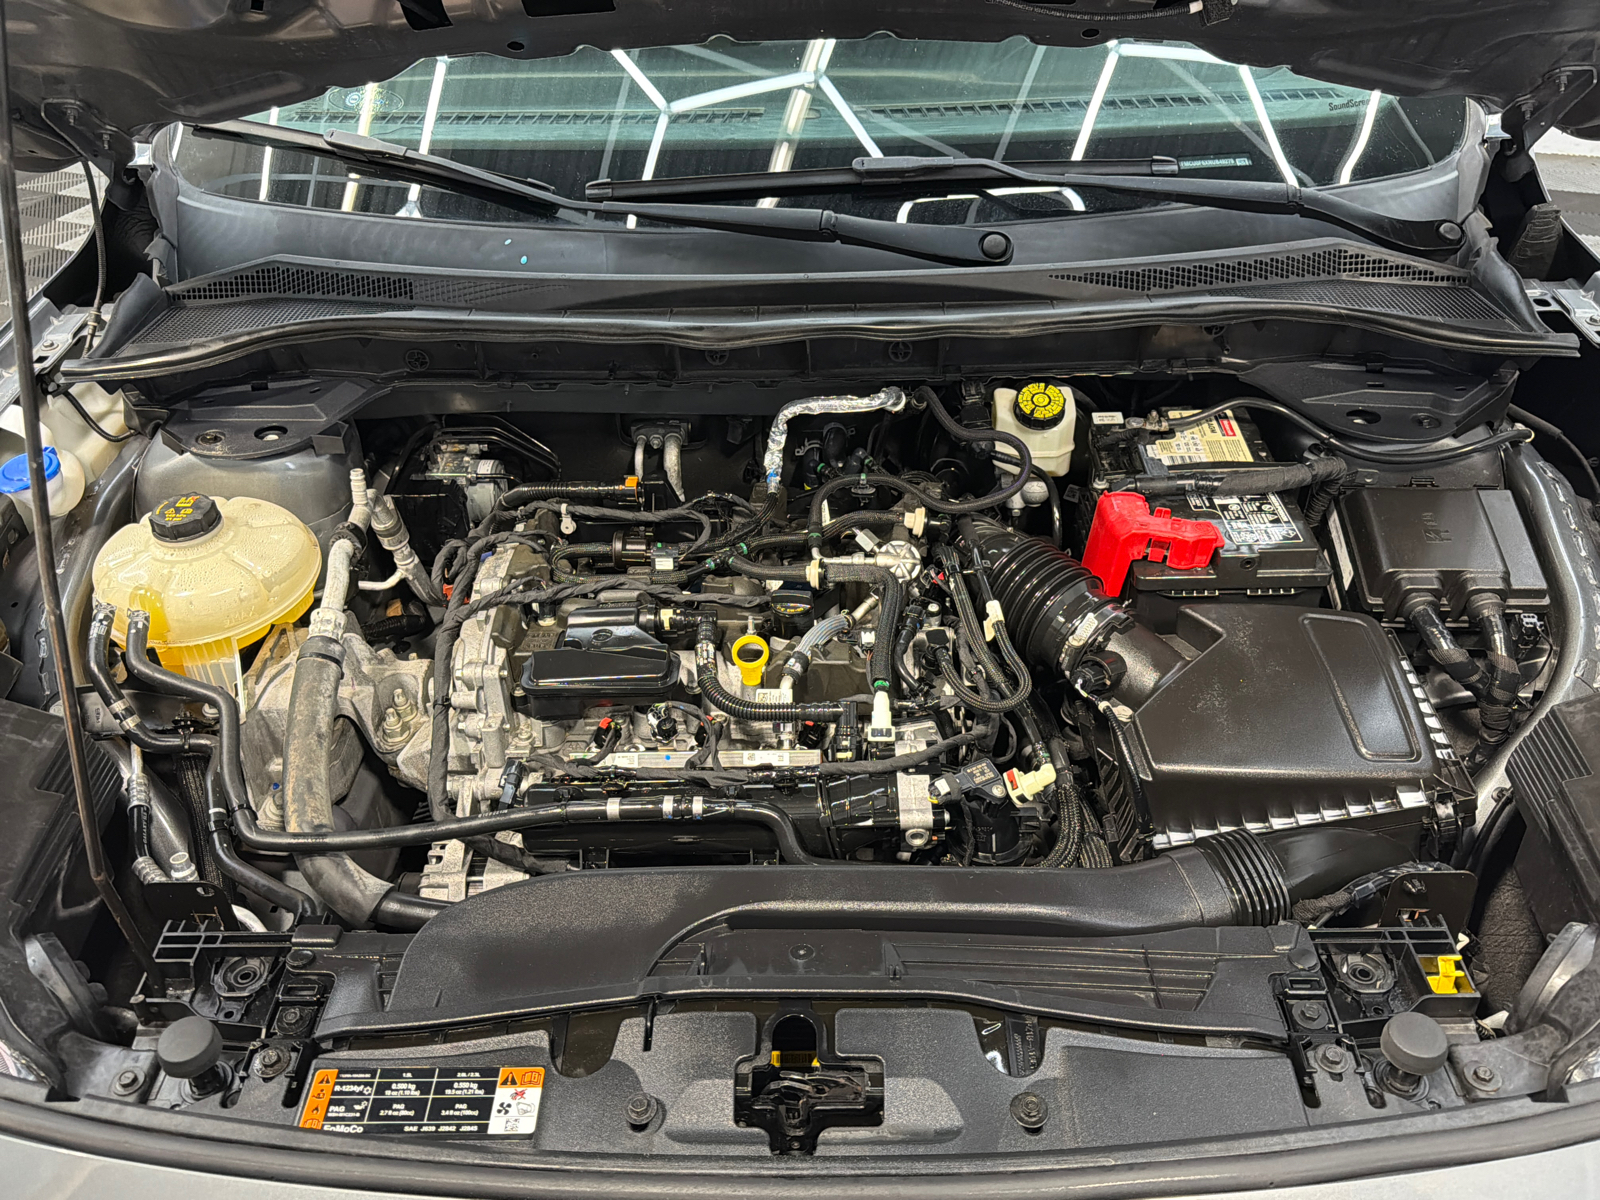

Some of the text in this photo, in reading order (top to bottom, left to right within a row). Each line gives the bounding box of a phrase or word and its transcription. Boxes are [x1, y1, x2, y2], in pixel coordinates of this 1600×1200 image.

[334, 1084, 364, 1093] R-1234yf
[408, 1083, 416, 1091] kg
[470, 1082, 479, 1090] kg
